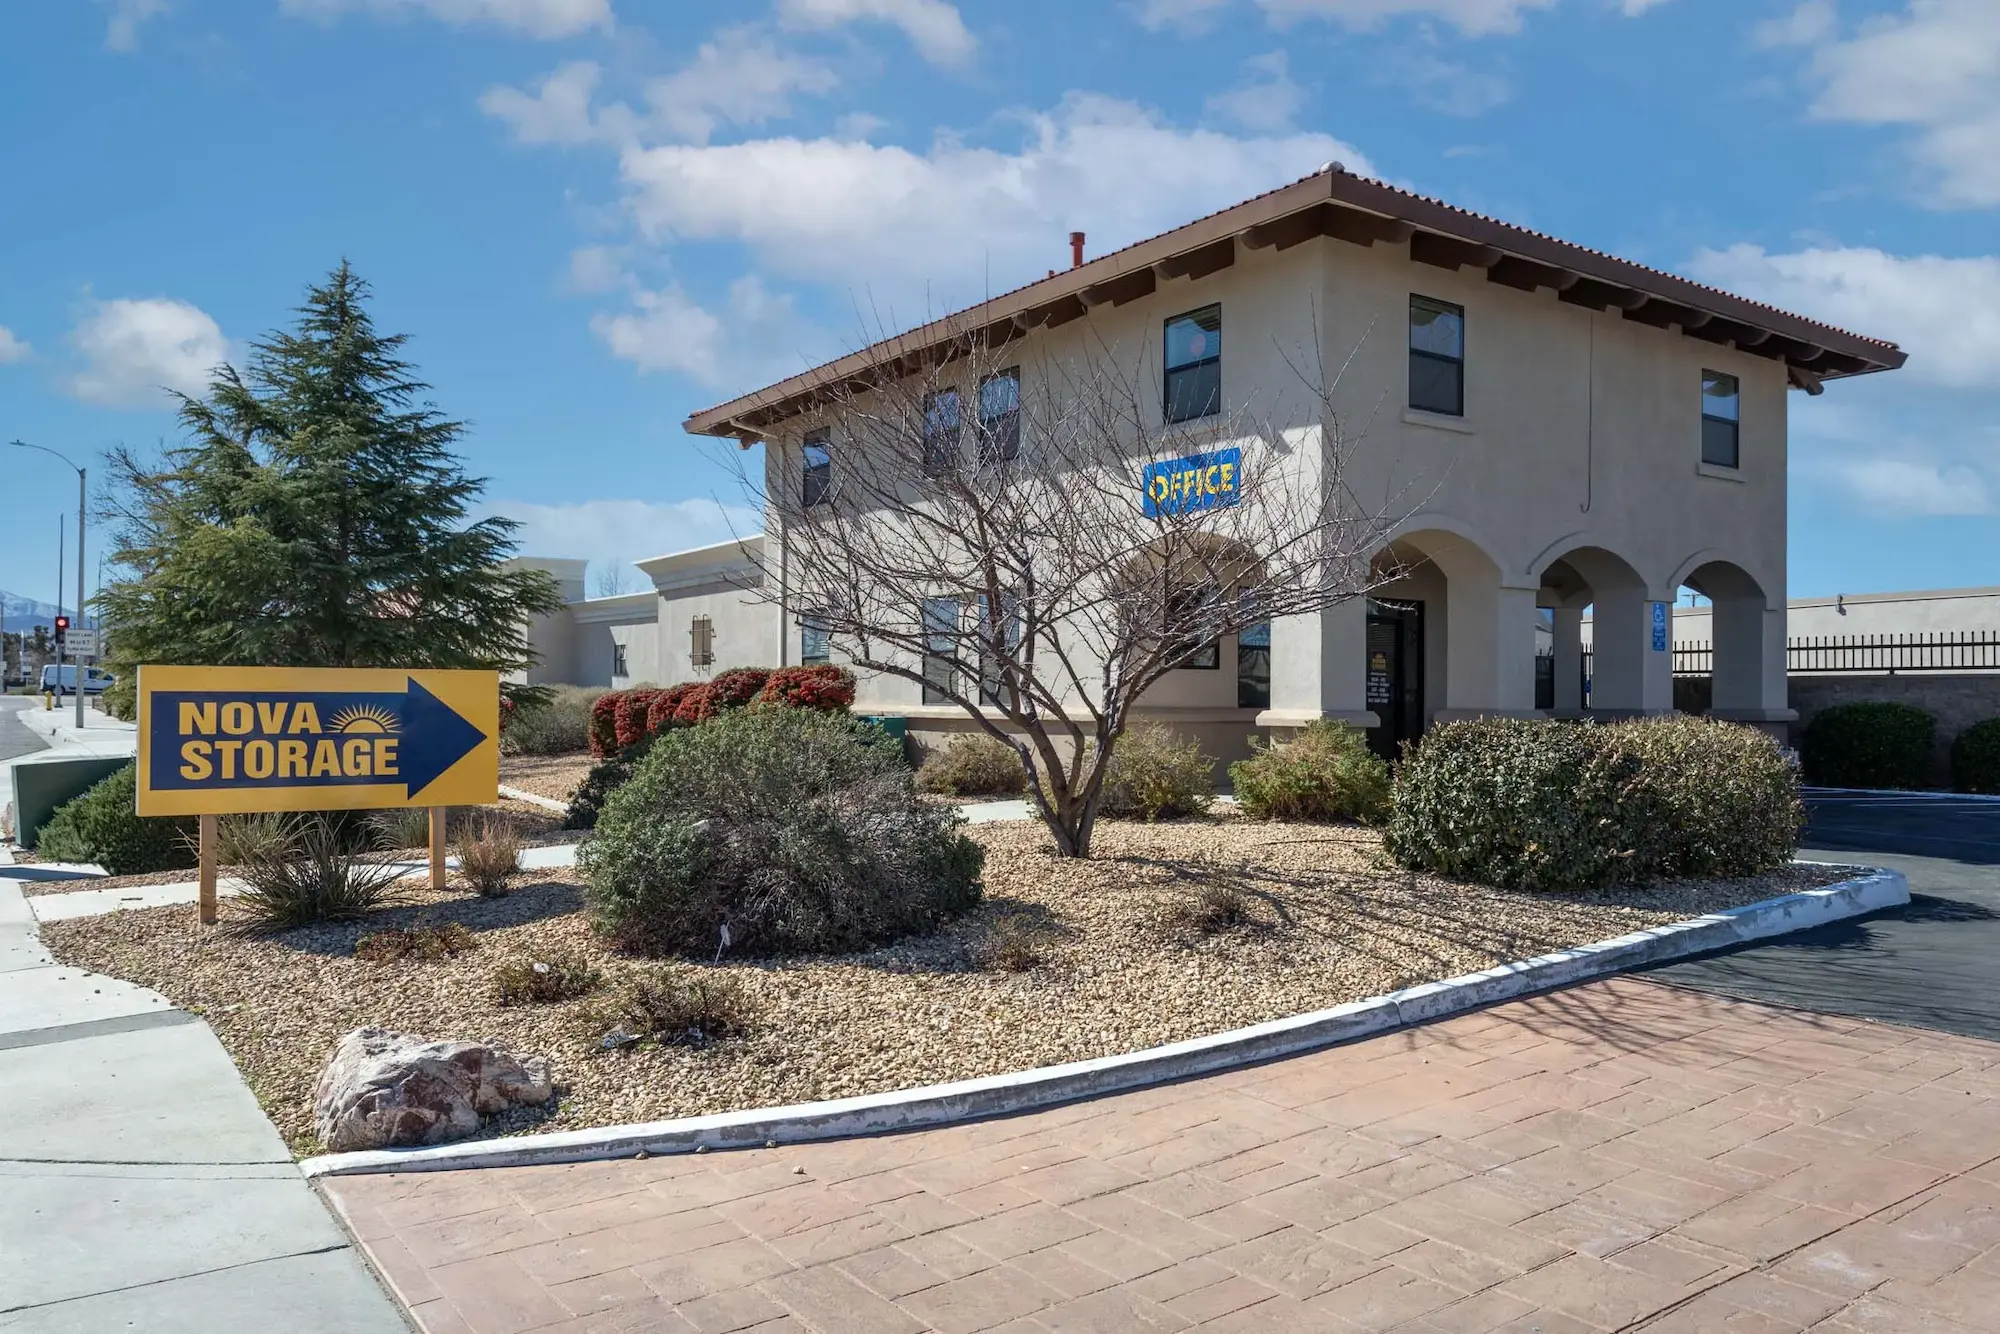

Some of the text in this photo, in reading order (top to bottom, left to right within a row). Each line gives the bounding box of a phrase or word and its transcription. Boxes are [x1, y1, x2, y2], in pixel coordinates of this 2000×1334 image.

[1149, 463, 1233, 502] OFFICE
[179, 702, 322, 735] NOVA
[180, 738, 398, 780] STORAGE
